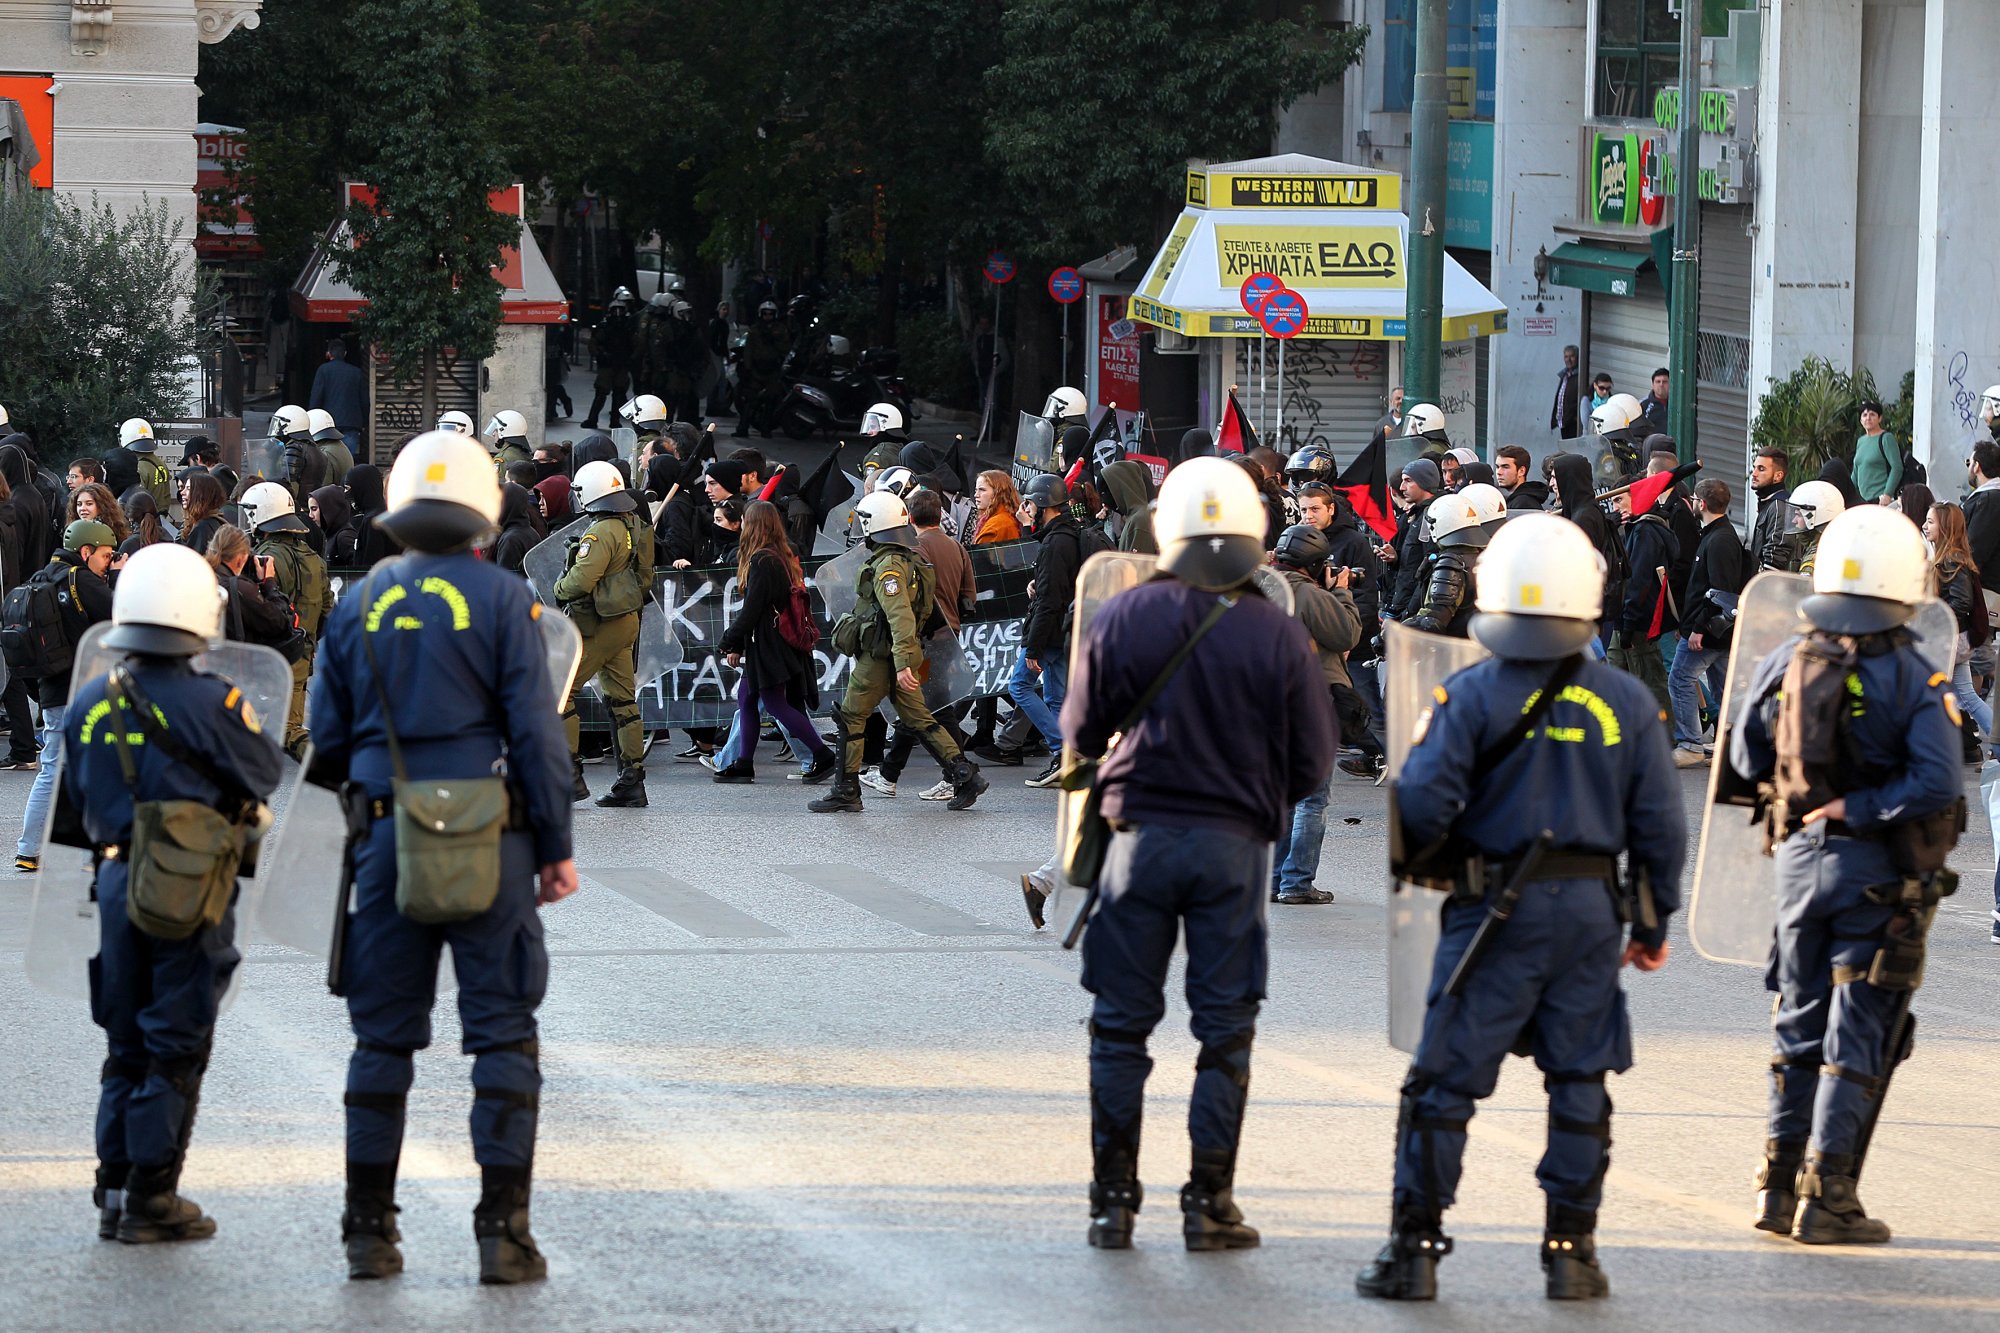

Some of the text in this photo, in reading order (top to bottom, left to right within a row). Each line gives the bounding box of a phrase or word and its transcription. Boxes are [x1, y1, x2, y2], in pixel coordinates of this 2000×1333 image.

[1655, 89, 1727, 134] ΦΑΡΚΕΙΟ
[198, 138, 248, 156] blic
[1661, 151, 1718, 200] Phcie
[1236, 180, 1314, 192] WESTERN
[1323, 180, 1369, 204] WU
[1261, 191, 1314, 203] UNION
[1223, 240, 1312, 254] ΣΤΕΙΛΤΕ & ΛΑΒΕΤΕ
[1318, 242, 1396, 267] ΕΔΩ
[1226, 253, 1317, 277] ΧΡΗΜΑΤΑ
[1235, 319, 1261, 329] paylin
[1306, 319, 1333, 327] TERN
